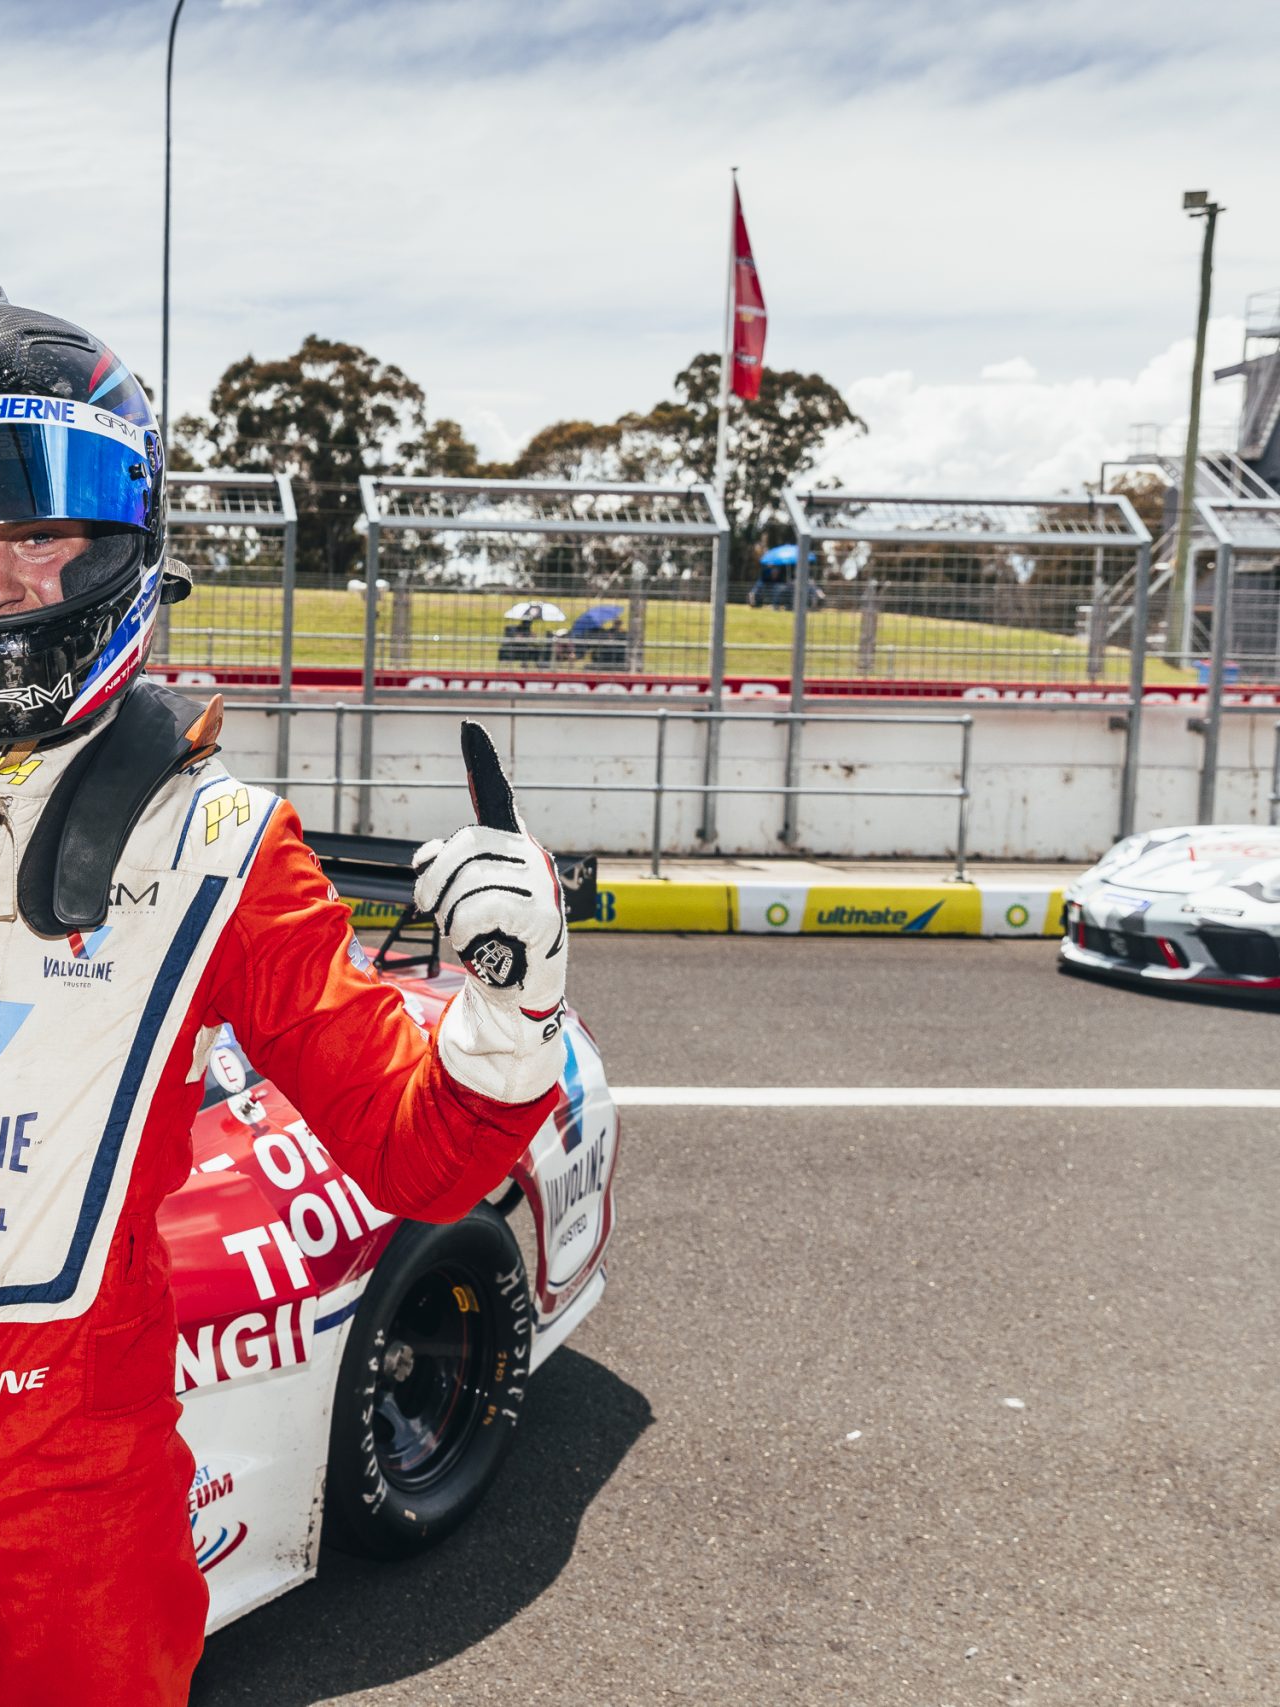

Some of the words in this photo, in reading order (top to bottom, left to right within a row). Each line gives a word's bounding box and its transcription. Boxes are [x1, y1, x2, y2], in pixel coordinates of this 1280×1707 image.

[202, 788, 251, 846] P1
[817, 906, 908, 925] ultimate
[43, 956, 115, 982] VALVOLINE
